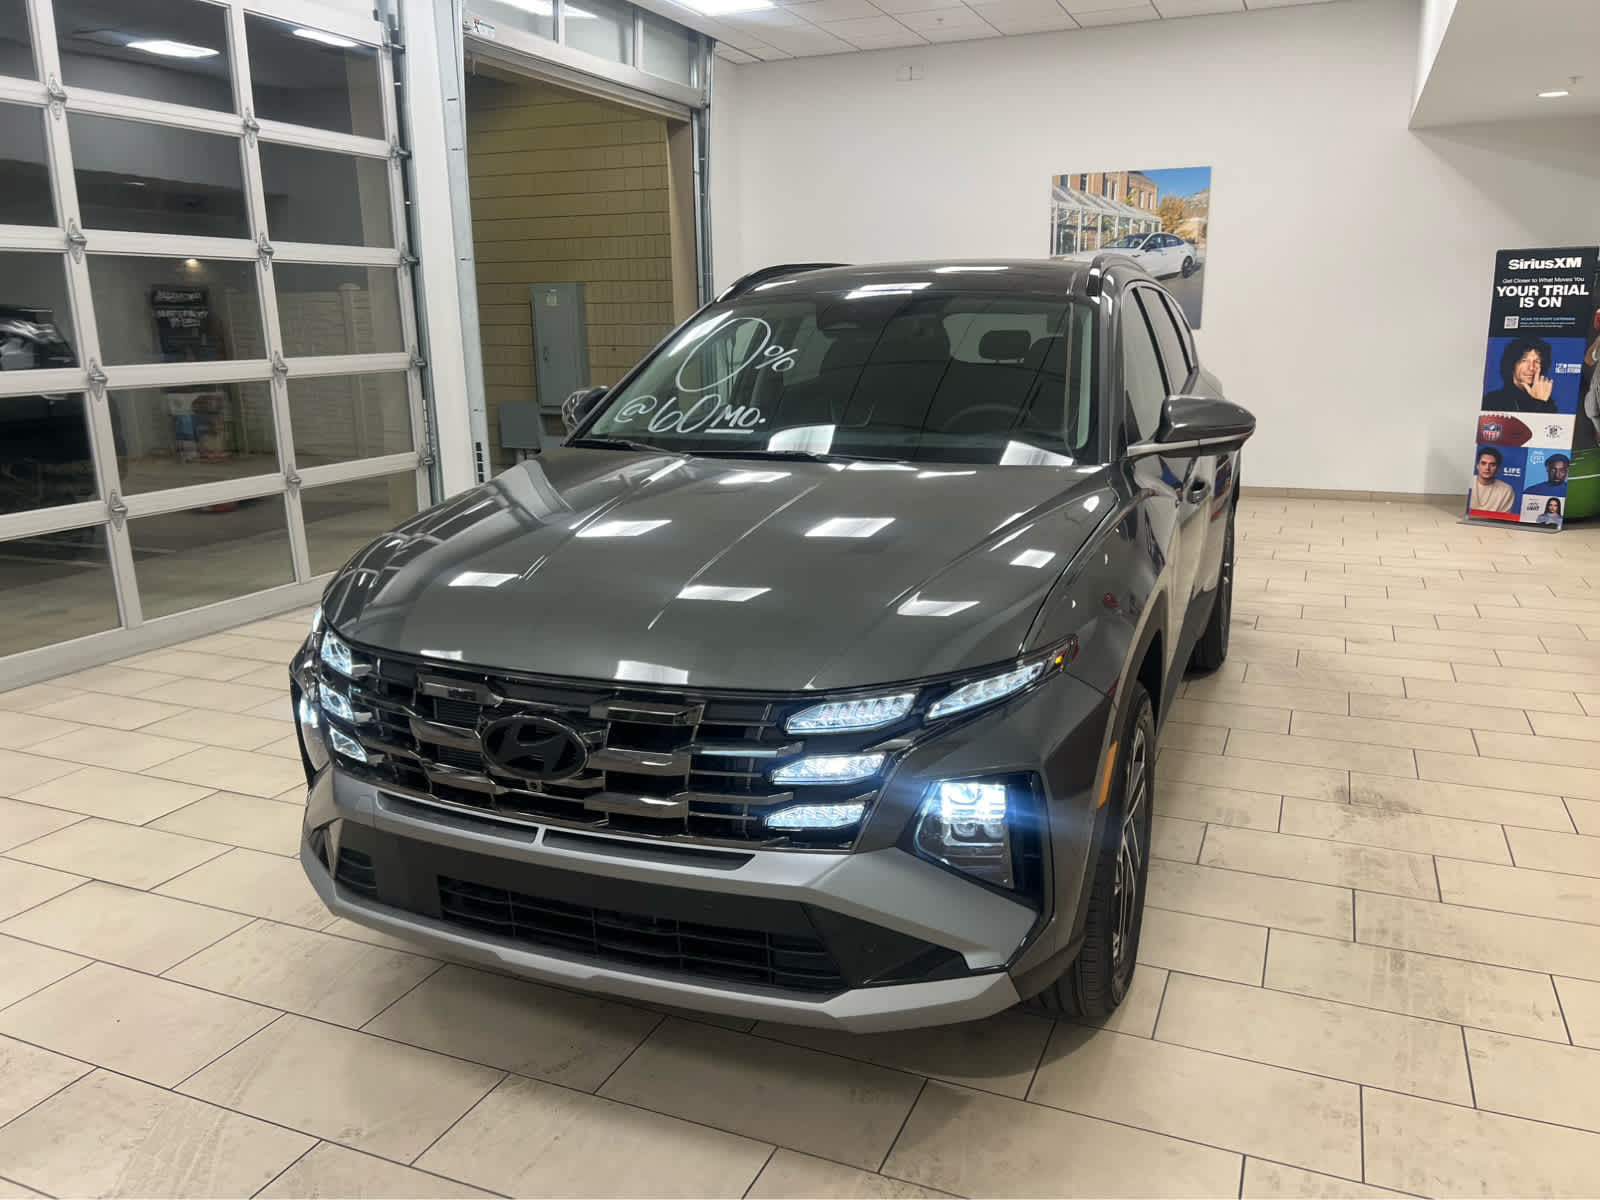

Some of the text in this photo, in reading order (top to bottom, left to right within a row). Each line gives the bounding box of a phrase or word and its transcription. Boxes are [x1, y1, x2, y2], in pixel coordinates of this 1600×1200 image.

[1508, 257, 1582, 270] SiriusXM
[1496, 284, 1589, 297] YOUR TRIAL
[1519, 296, 1562, 308] IS ON
[1503, 466, 1521, 474] LIFE
